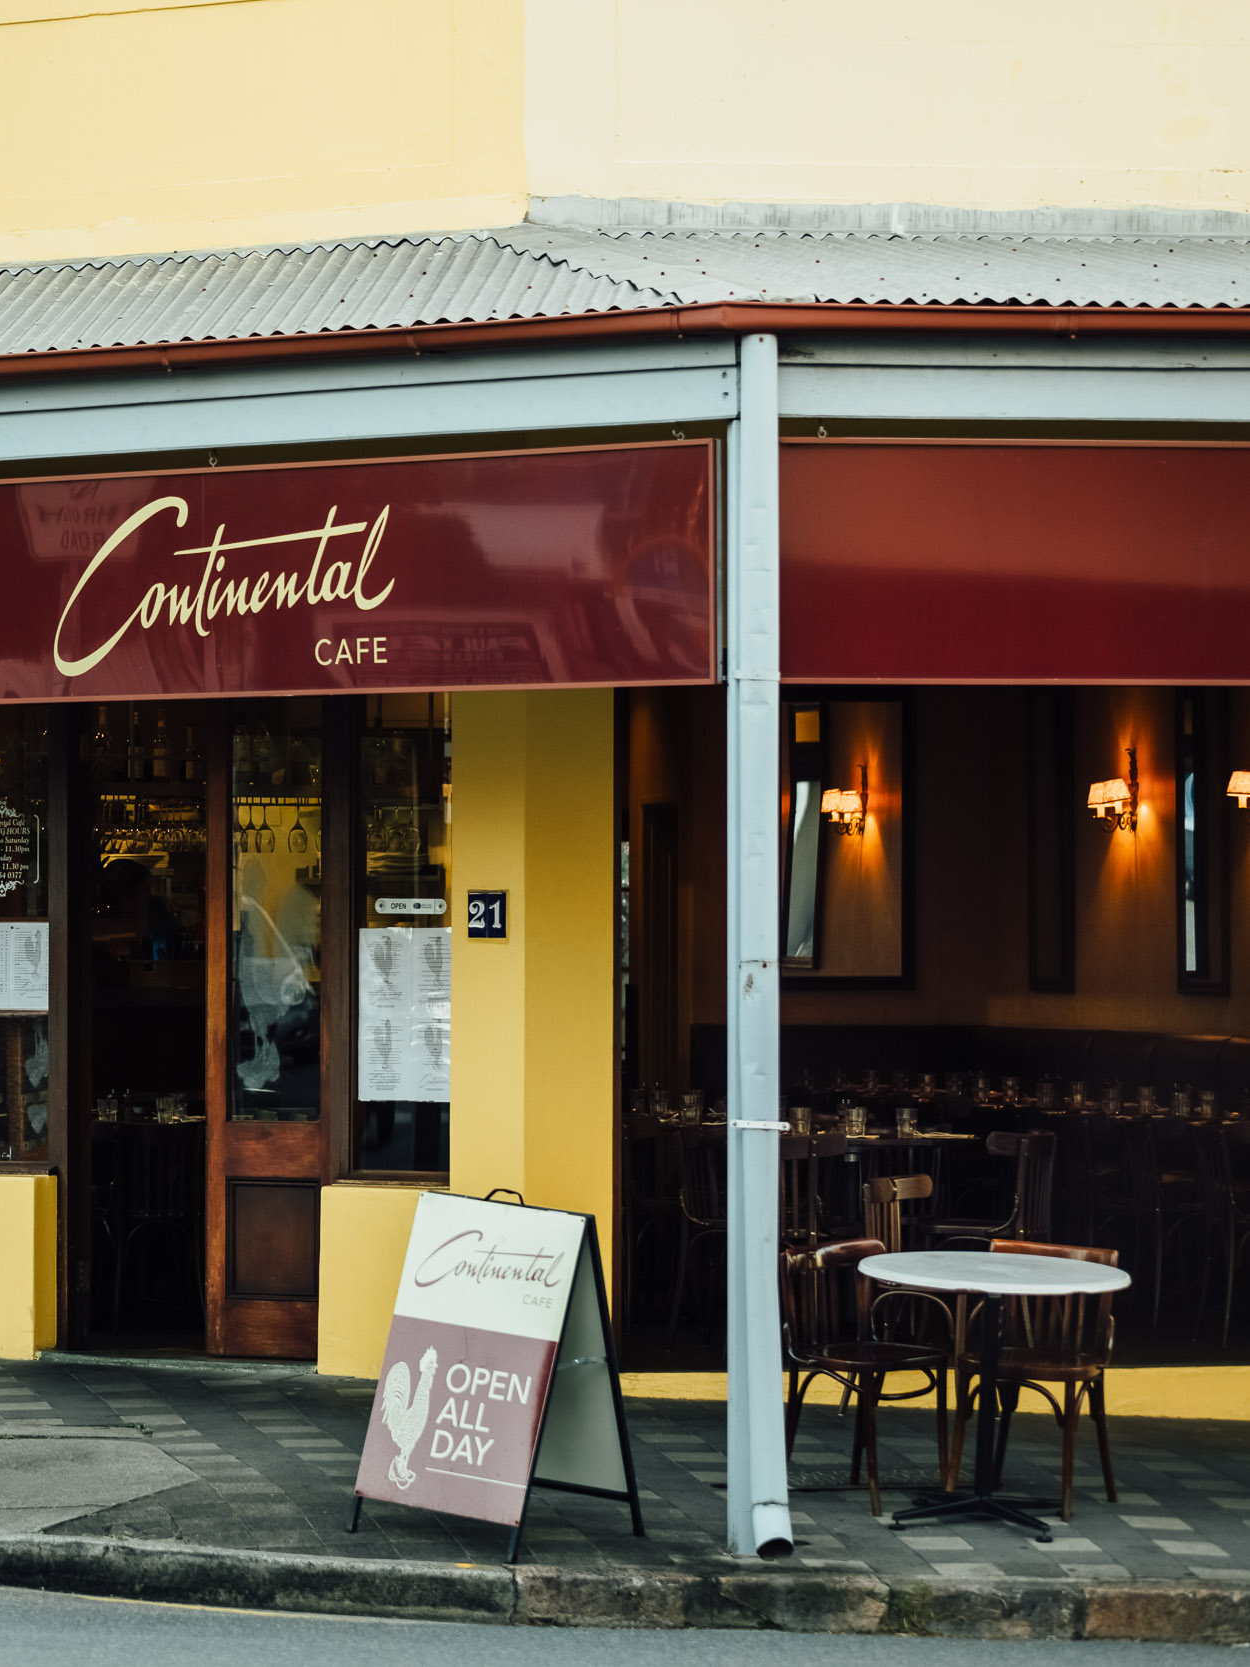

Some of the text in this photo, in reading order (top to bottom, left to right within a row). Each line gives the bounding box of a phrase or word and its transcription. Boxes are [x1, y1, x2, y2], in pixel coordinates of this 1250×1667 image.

[53, 496, 395, 677] Continental
[314, 637, 388, 666] CAFE
[4, 836, 30, 845] Saturday
[6, 827, 31, 835] HOURS
[5, 845, 30, 854] 11.30pm
[7, 871, 23, 879] 0377
[390, 902, 407, 910] OPEN
[467, 900, 502, 928] 21
[414, 1230, 565, 1288] Continental
[522, 1294, 554, 1309] CAFE
[446, 1363, 532, 1405] OPEN
[435, 1397, 490, 1433] ALL
[430, 1429, 495, 1467] DAY
